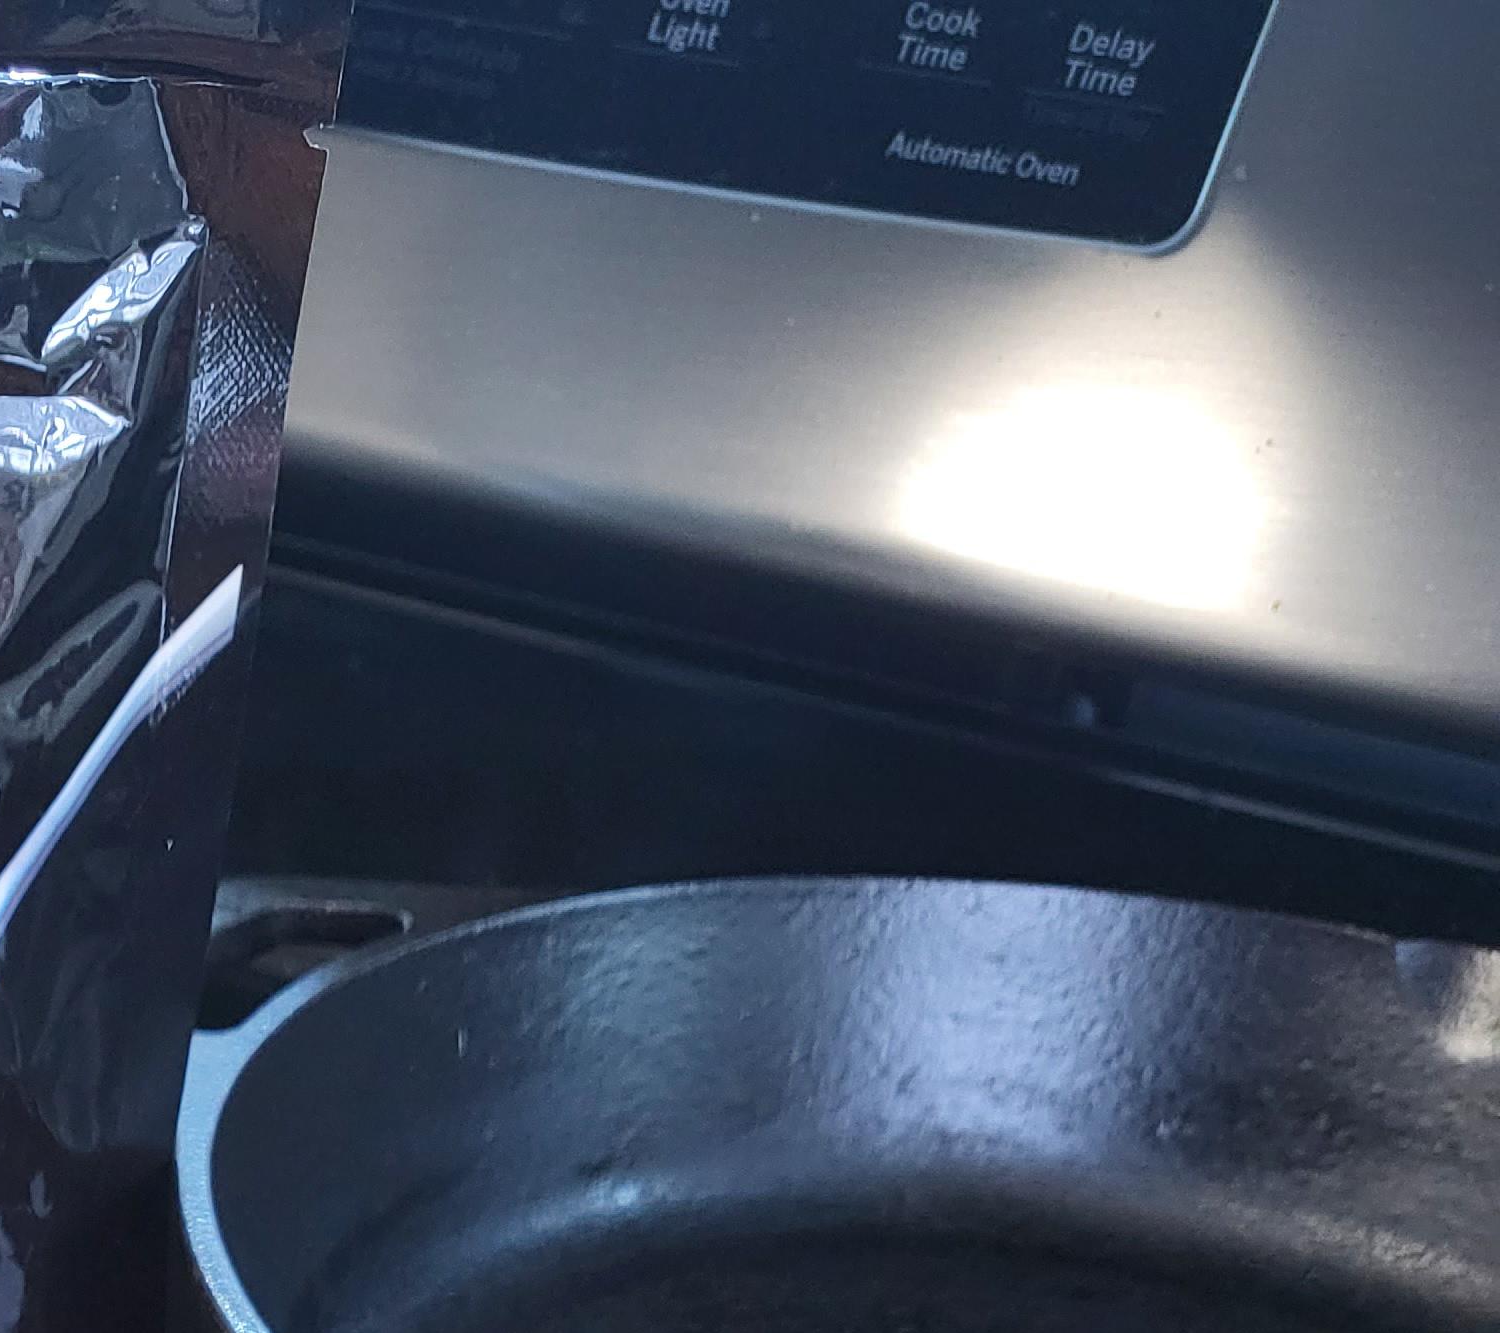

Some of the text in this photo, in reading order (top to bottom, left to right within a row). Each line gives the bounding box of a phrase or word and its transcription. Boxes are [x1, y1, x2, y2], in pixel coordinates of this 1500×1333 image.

[647, 11, 720, 52] Light
[905, 1, 982, 39] Cook
[897, 34, 968, 71] Time
[1068, 22, 1156, 69] Delay
[1064, 59, 1138, 97] Time
[885, 131, 1081, 187] Automatic Oven
